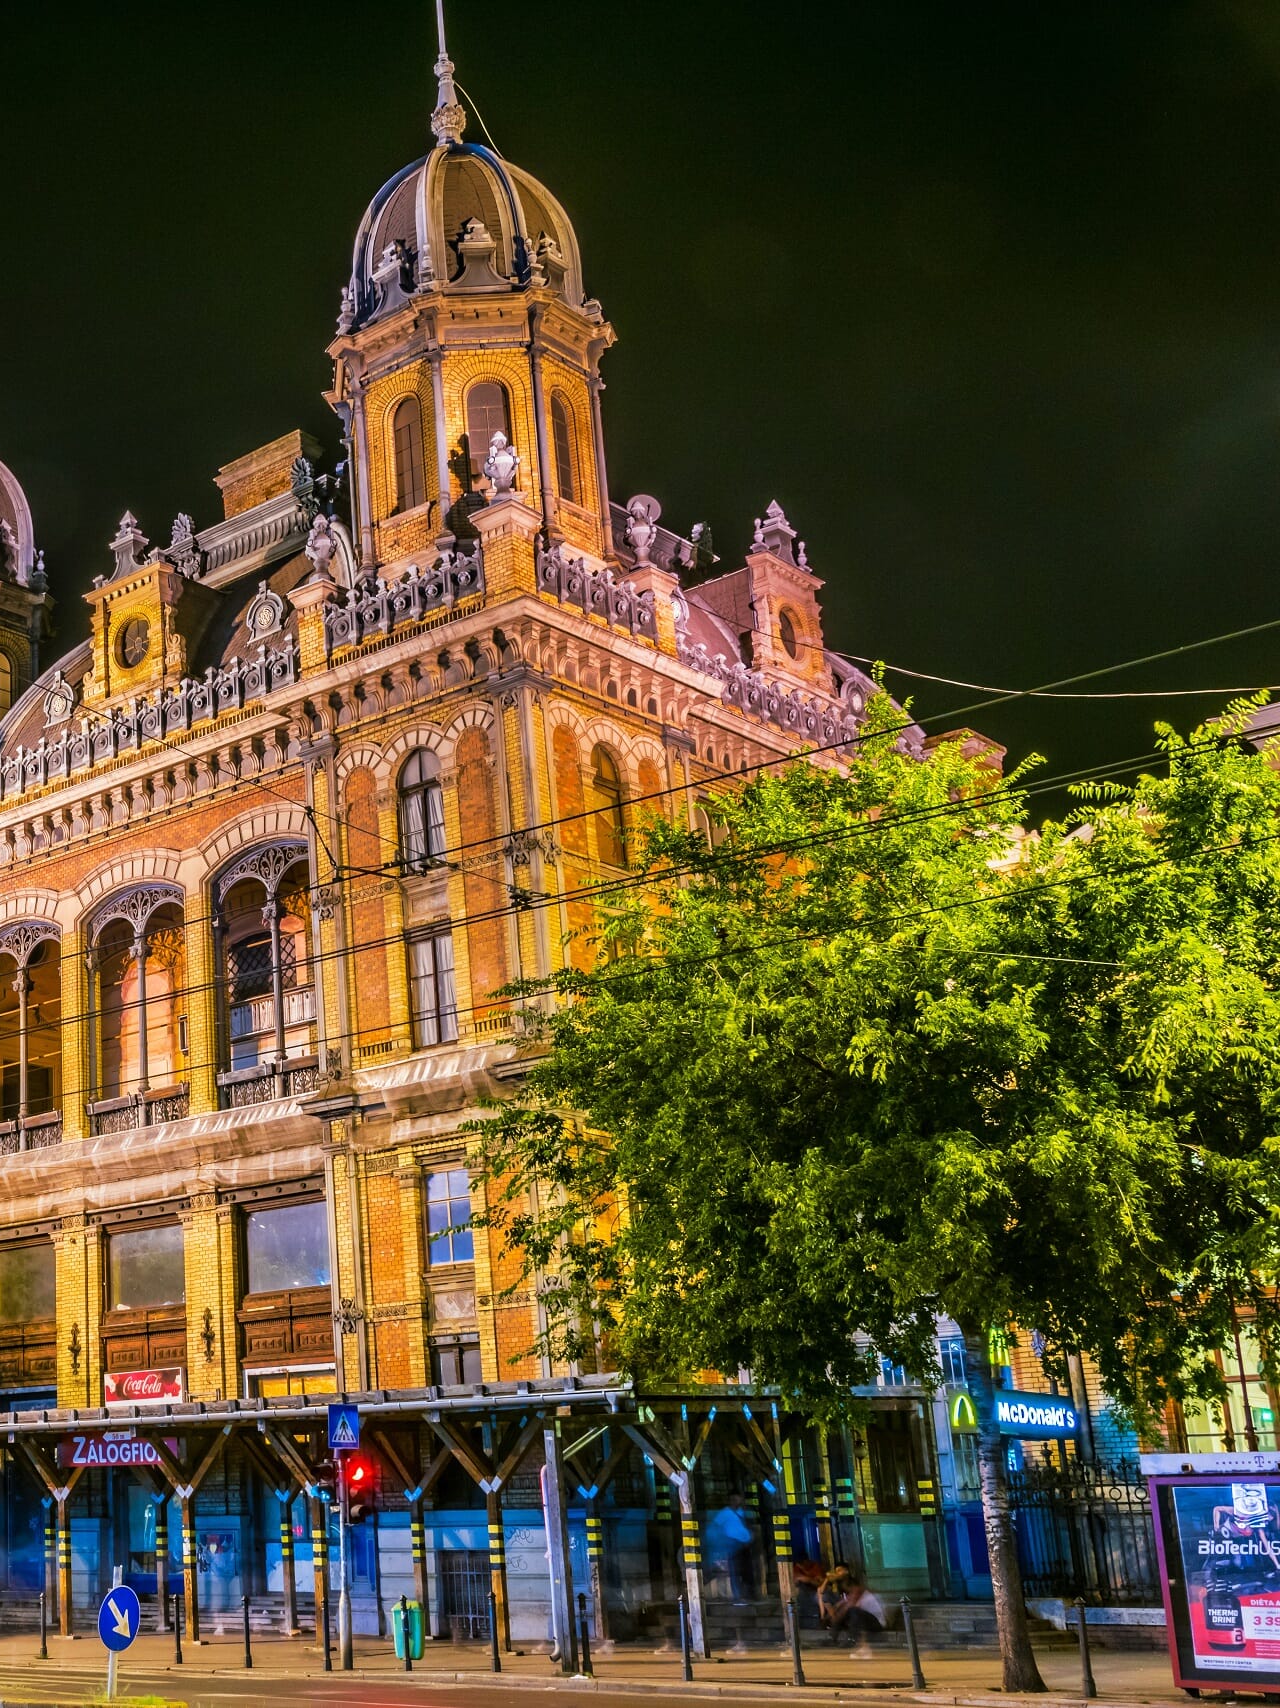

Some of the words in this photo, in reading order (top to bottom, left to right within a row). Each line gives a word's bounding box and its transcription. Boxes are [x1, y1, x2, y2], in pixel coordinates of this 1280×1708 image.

[123, 1374, 162, 1395] Coca-Cola
[998, 1401, 1075, 1428] McDonald's
[1208, 1609, 1238, 1617] THERMO
[1212, 1616, 1236, 1624] DRINE
